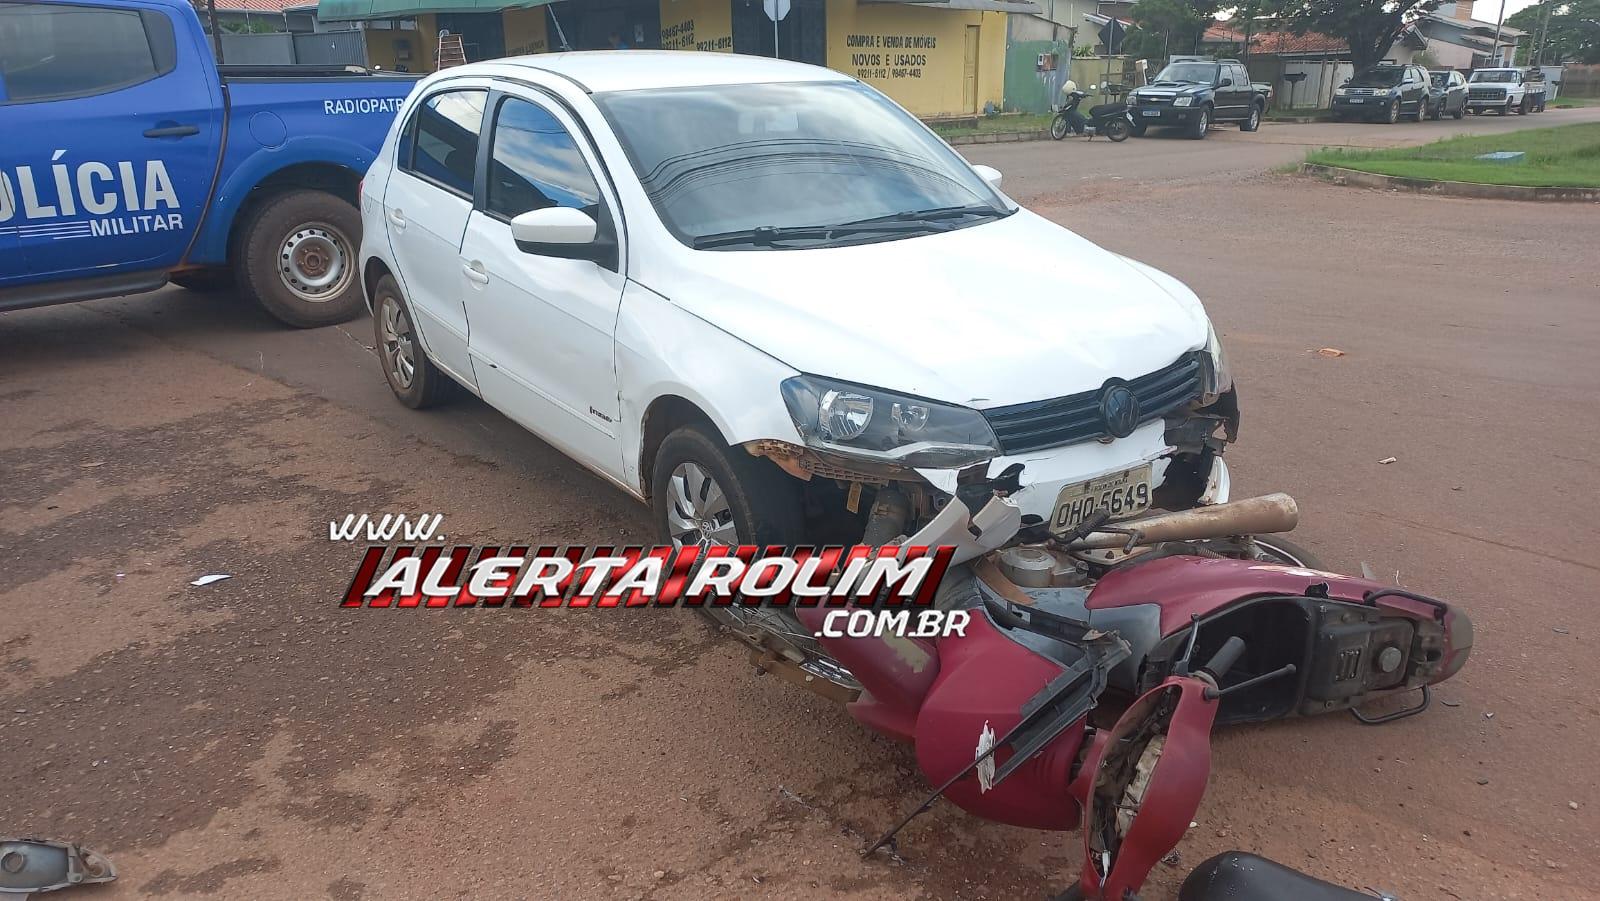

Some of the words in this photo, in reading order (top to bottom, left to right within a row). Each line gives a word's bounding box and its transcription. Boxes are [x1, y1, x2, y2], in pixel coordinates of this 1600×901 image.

[846, 34, 874, 48] COMPRA
[876, 35, 880, 48] E
[883, 35, 903, 48] VENDA
[904, 36, 912, 48] DE
[913, 34, 936, 48] MÓVEIS
[852, 53, 880, 66] NOVOS
[885, 54, 890, 66] E
[894, 54, 926, 66] USADOS
[90, 213, 183, 237] MILITAR
